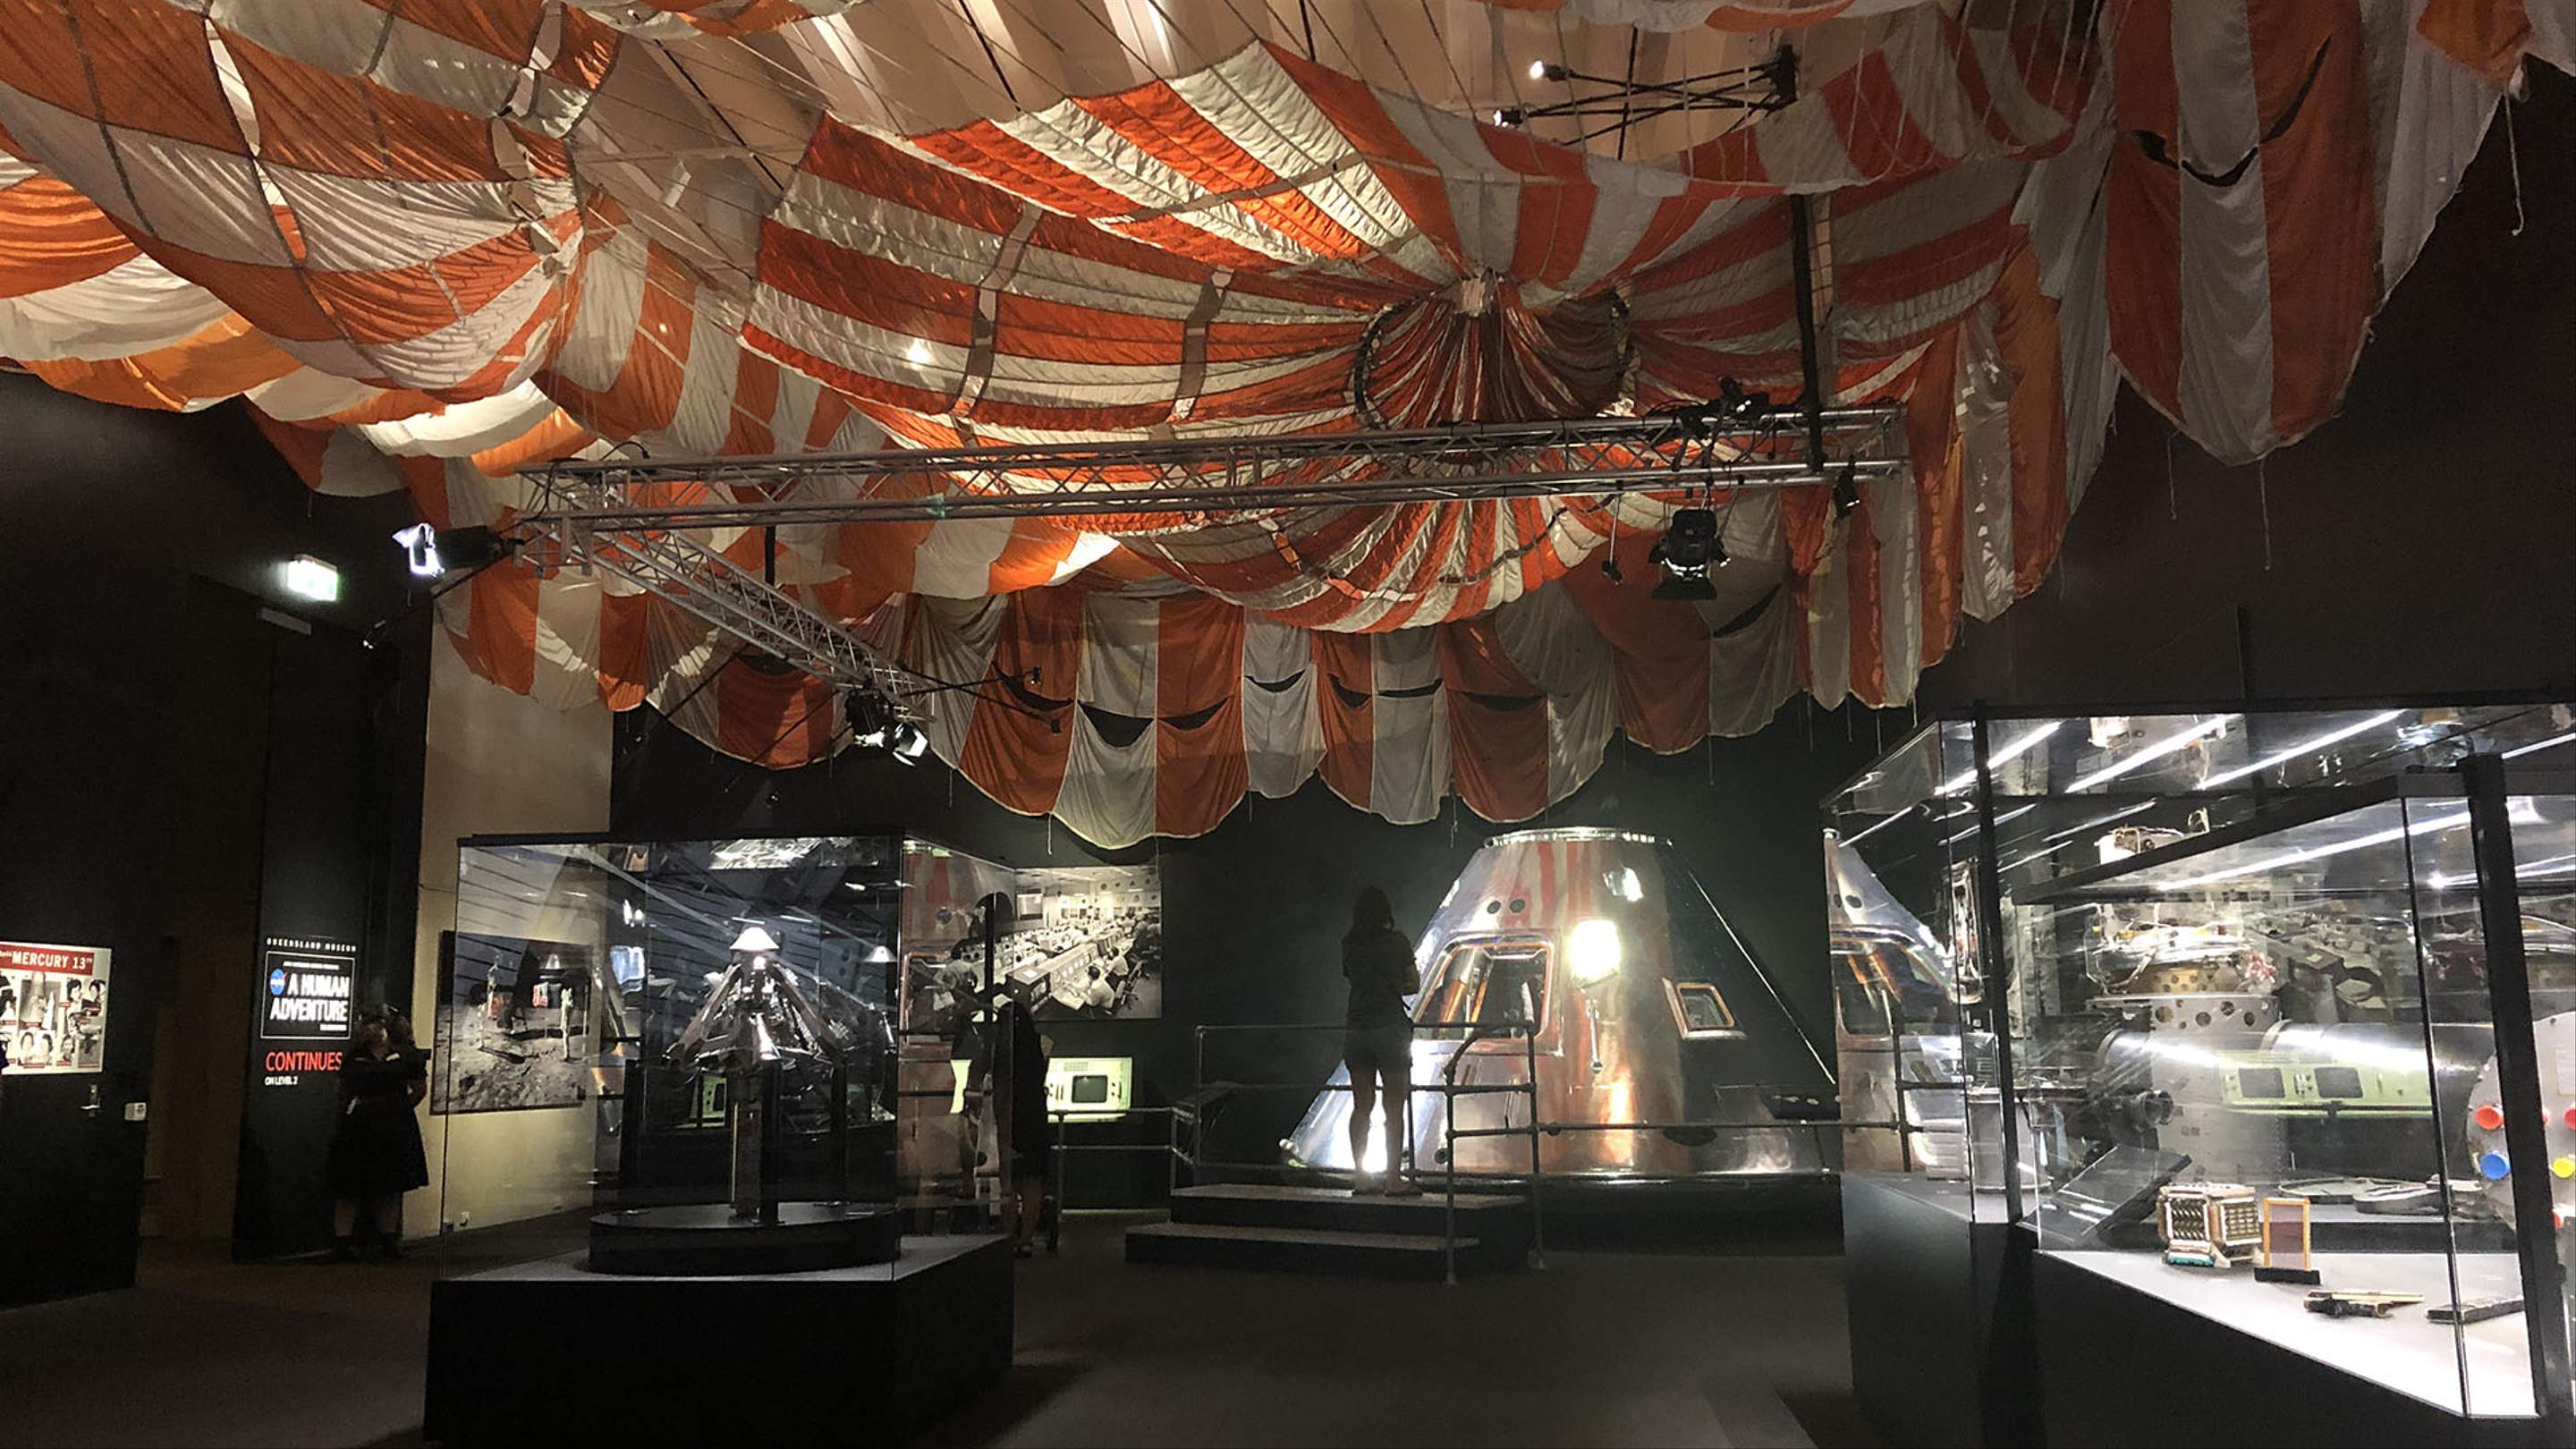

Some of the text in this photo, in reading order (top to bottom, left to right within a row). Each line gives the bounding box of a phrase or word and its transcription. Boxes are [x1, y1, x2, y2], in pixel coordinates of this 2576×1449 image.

[287, 972, 351, 998] A HUMAN
[269, 997, 349, 1021] ADVENTURE
[266, 1051, 343, 1072] CONTINUES
